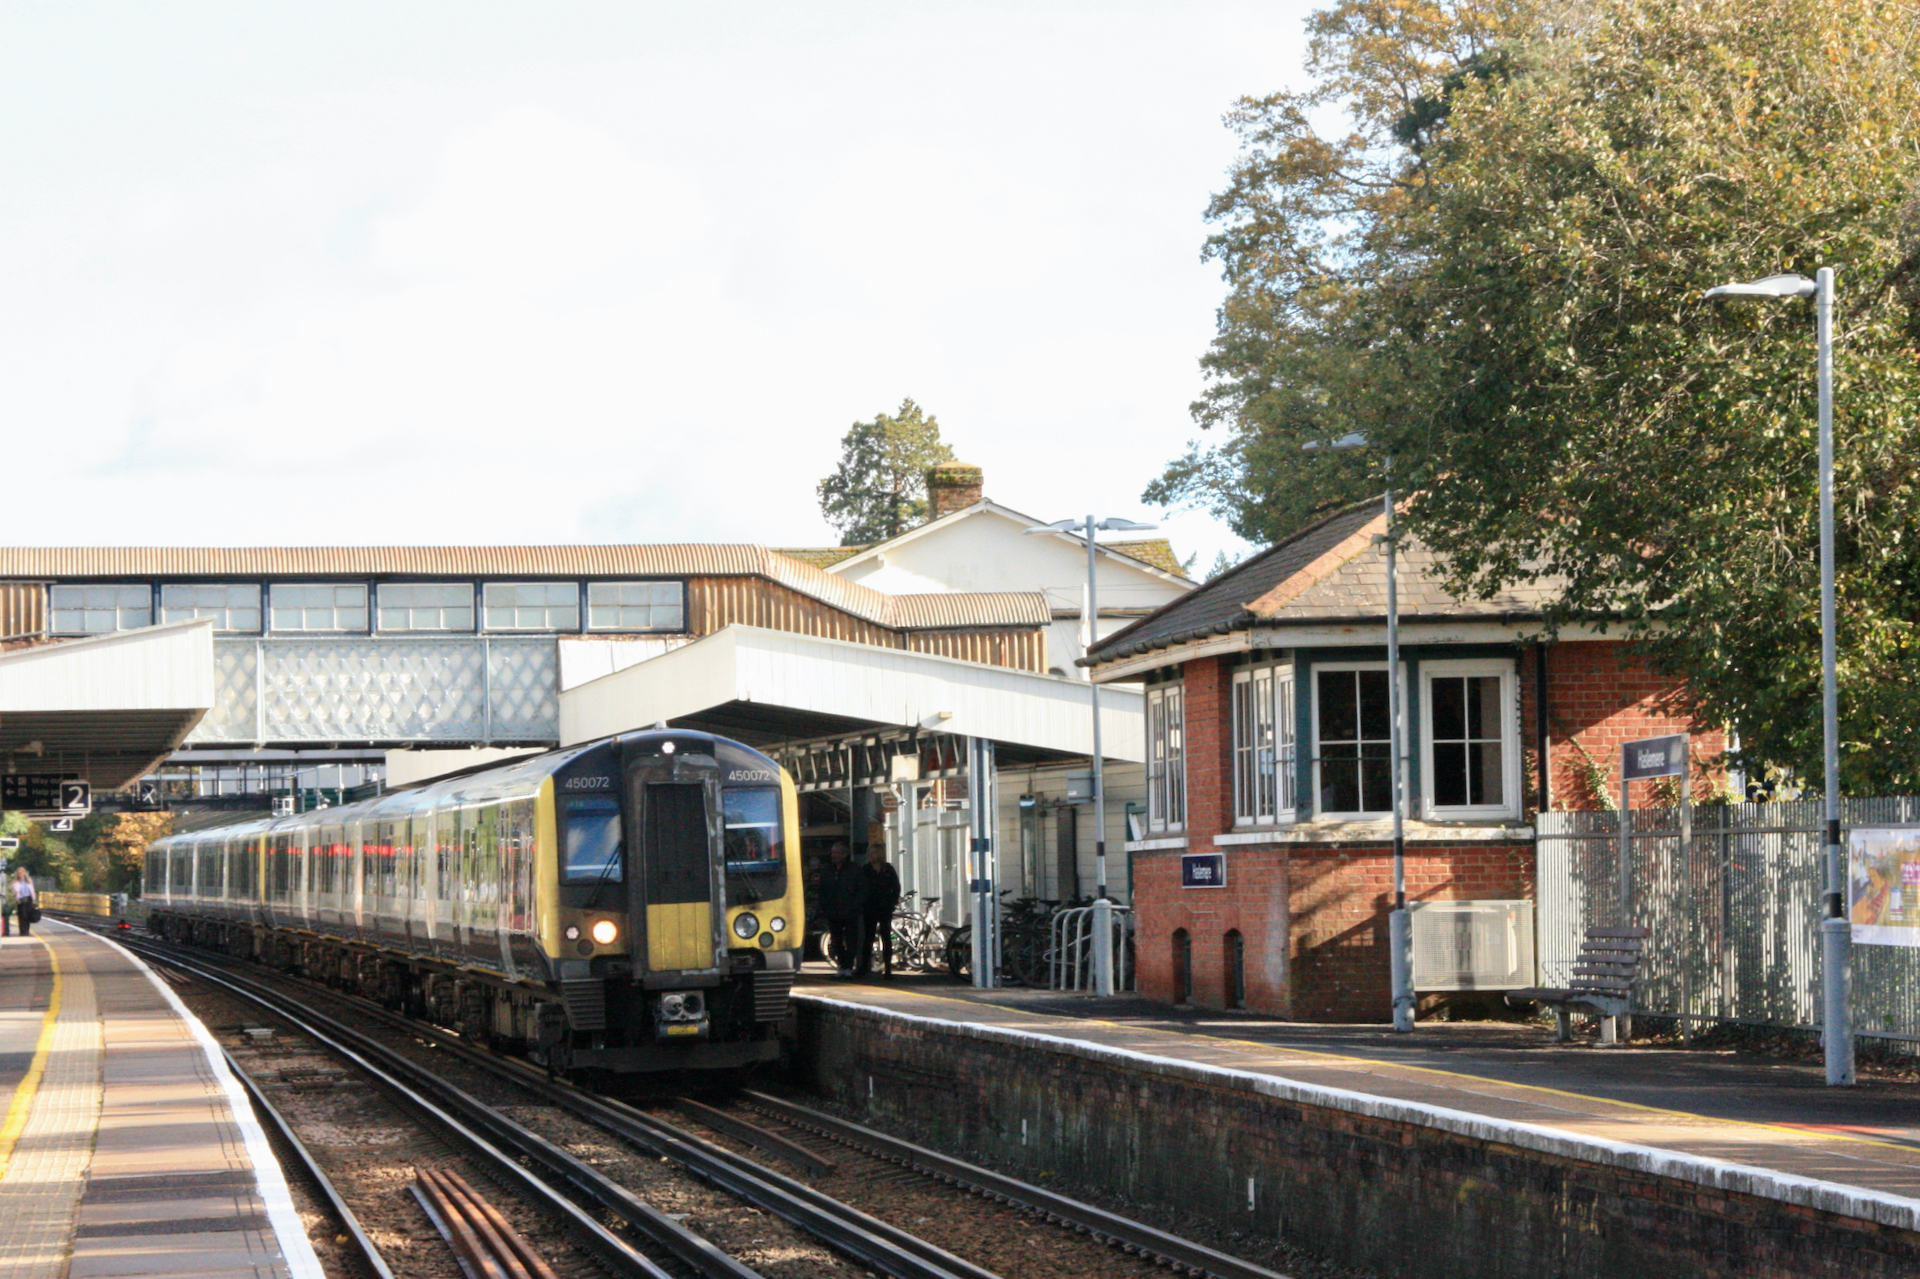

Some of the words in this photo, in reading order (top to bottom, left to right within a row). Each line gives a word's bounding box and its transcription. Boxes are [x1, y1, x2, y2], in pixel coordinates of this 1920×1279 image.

[1638, 749, 1664, 769] Haslemere
[31, 776, 48, 785] Way
[728, 770, 770, 781] 450072
[565, 776, 610, 789] 450072
[68, 786, 84, 808] 2
